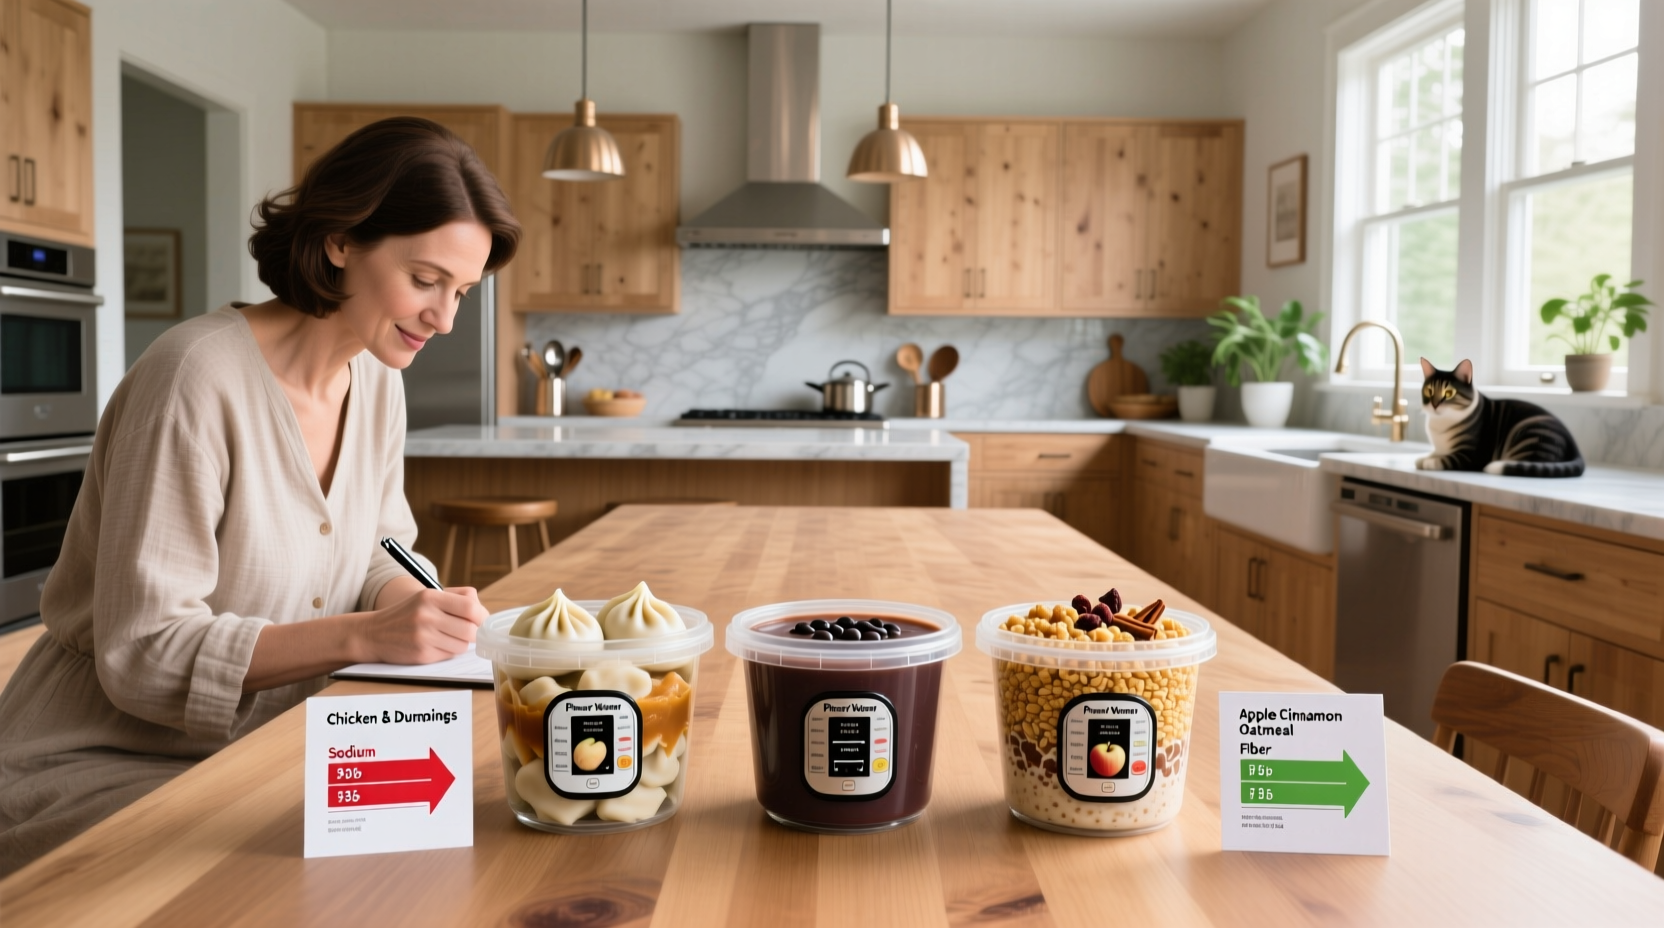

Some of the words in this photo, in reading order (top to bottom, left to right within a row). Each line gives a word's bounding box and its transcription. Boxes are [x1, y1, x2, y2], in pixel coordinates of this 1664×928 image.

[327, 711, 378, 725] Chicken
[381, 710, 391, 724] &
[1239, 708, 1277, 723] Apple
[1279, 708, 1343, 722] Cinnamon
[1239, 723, 1294, 736] Oatmeal
[328, 745, 376, 759] Sodium
